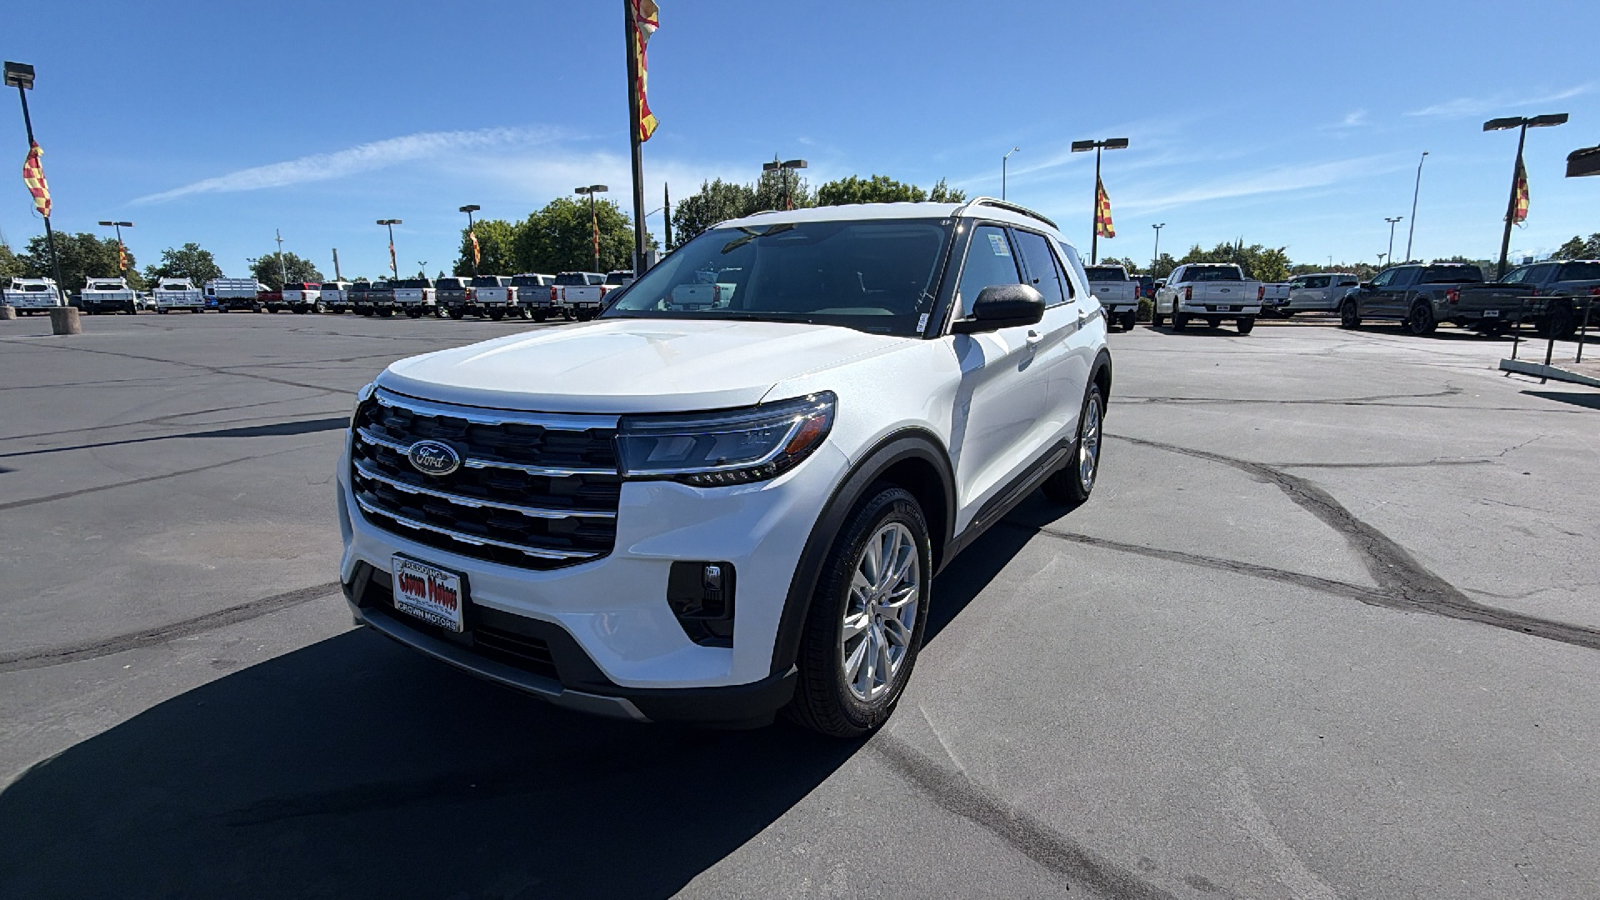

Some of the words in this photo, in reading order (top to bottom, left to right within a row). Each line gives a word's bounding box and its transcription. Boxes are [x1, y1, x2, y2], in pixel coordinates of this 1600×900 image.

[416, 446, 449, 467] Ford
[405, 561, 440, 578] REDDING
[398, 602, 424, 618] CROWN
[425, 613, 457, 630] MOTORS
